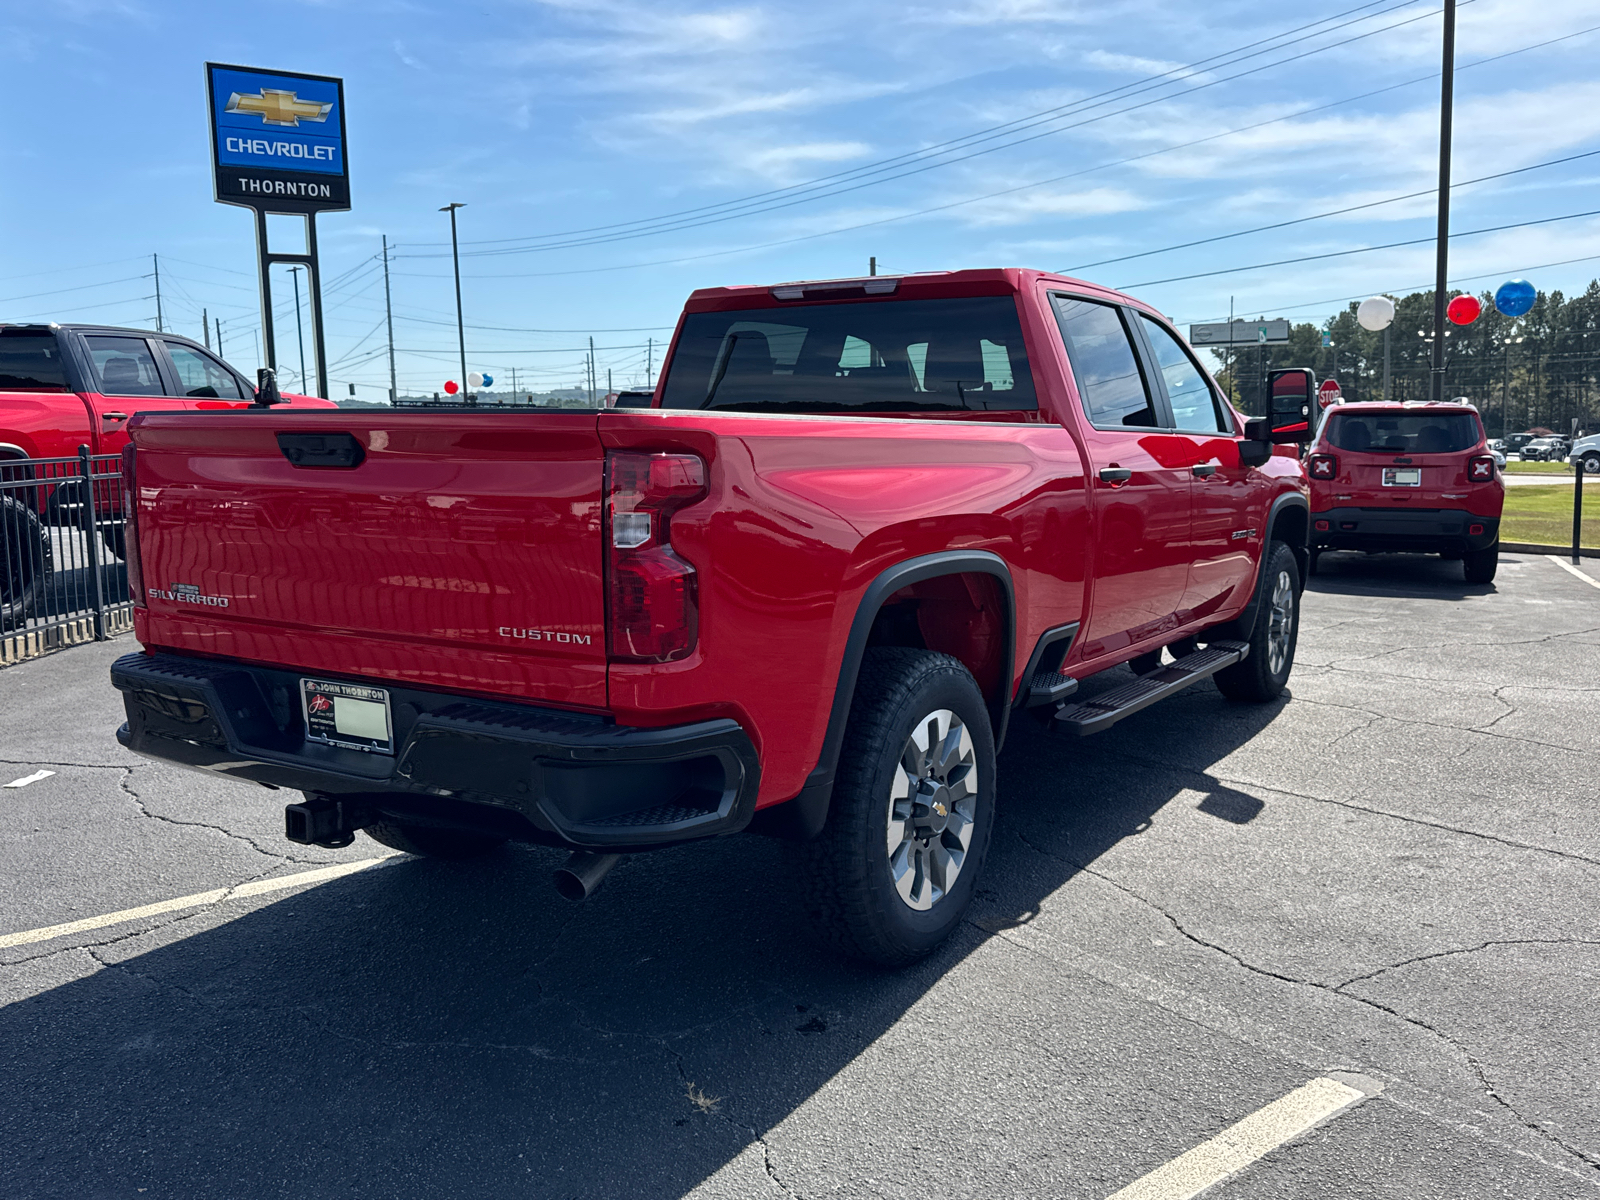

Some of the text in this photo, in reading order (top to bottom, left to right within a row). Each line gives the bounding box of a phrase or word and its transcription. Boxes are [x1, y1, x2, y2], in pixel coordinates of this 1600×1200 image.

[226, 137, 335, 160] CHEVROLET
[238, 178, 330, 197] THORNTON
[1320, 390, 1340, 403] STOP
[148, 588, 229, 607] SILVERADO
[499, 626, 591, 645] CUSTOM
[320, 683, 383, 699] JOHN THORNTON
